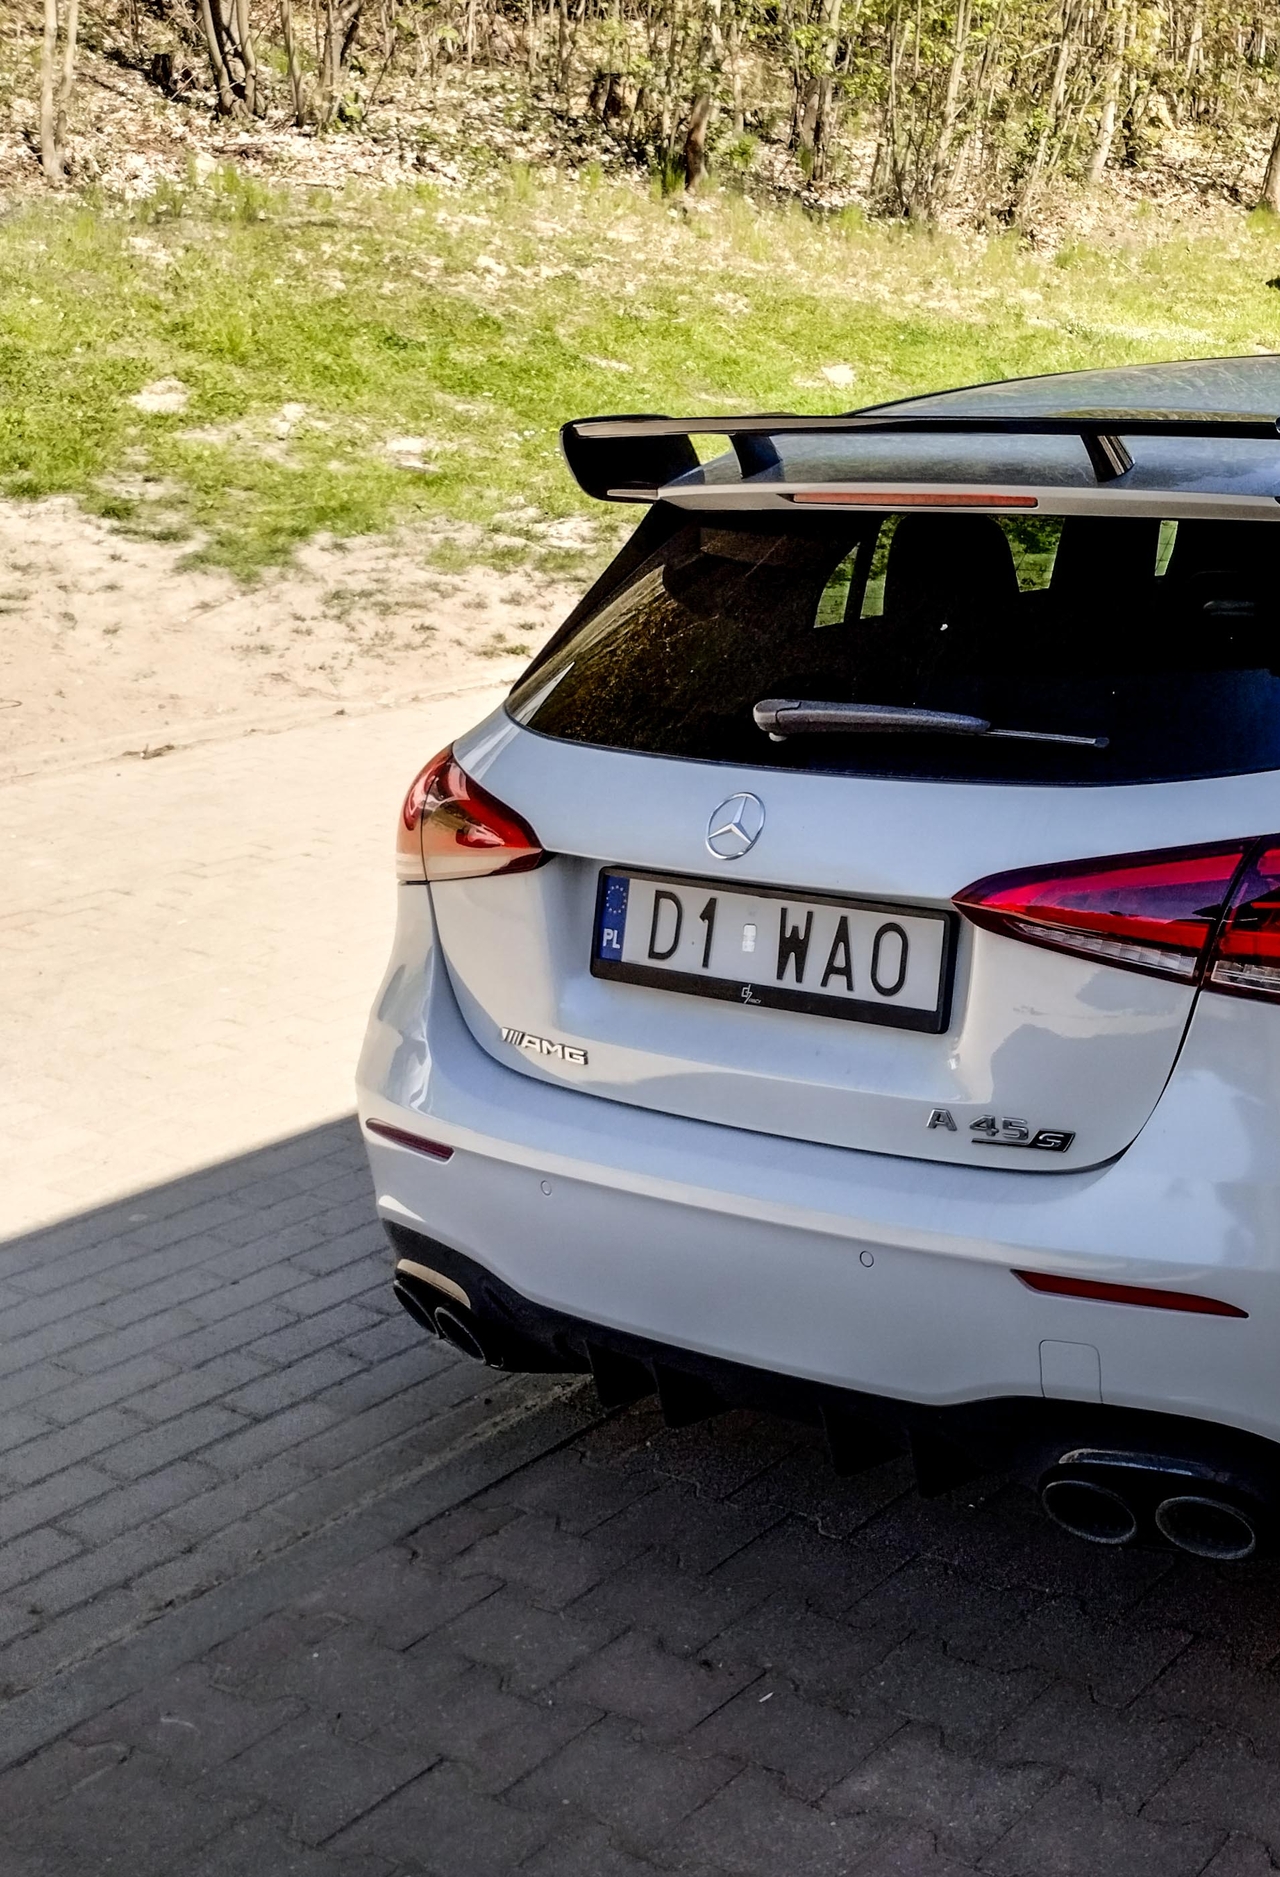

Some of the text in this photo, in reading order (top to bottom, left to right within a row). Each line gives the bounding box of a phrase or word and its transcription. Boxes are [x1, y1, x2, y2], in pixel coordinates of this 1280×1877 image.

[602, 927, 621, 949] PL
[648, 889, 909, 997] D1 WAO
[521, 1033, 589, 1066] AMG
[926, 1108, 958, 1132] A
